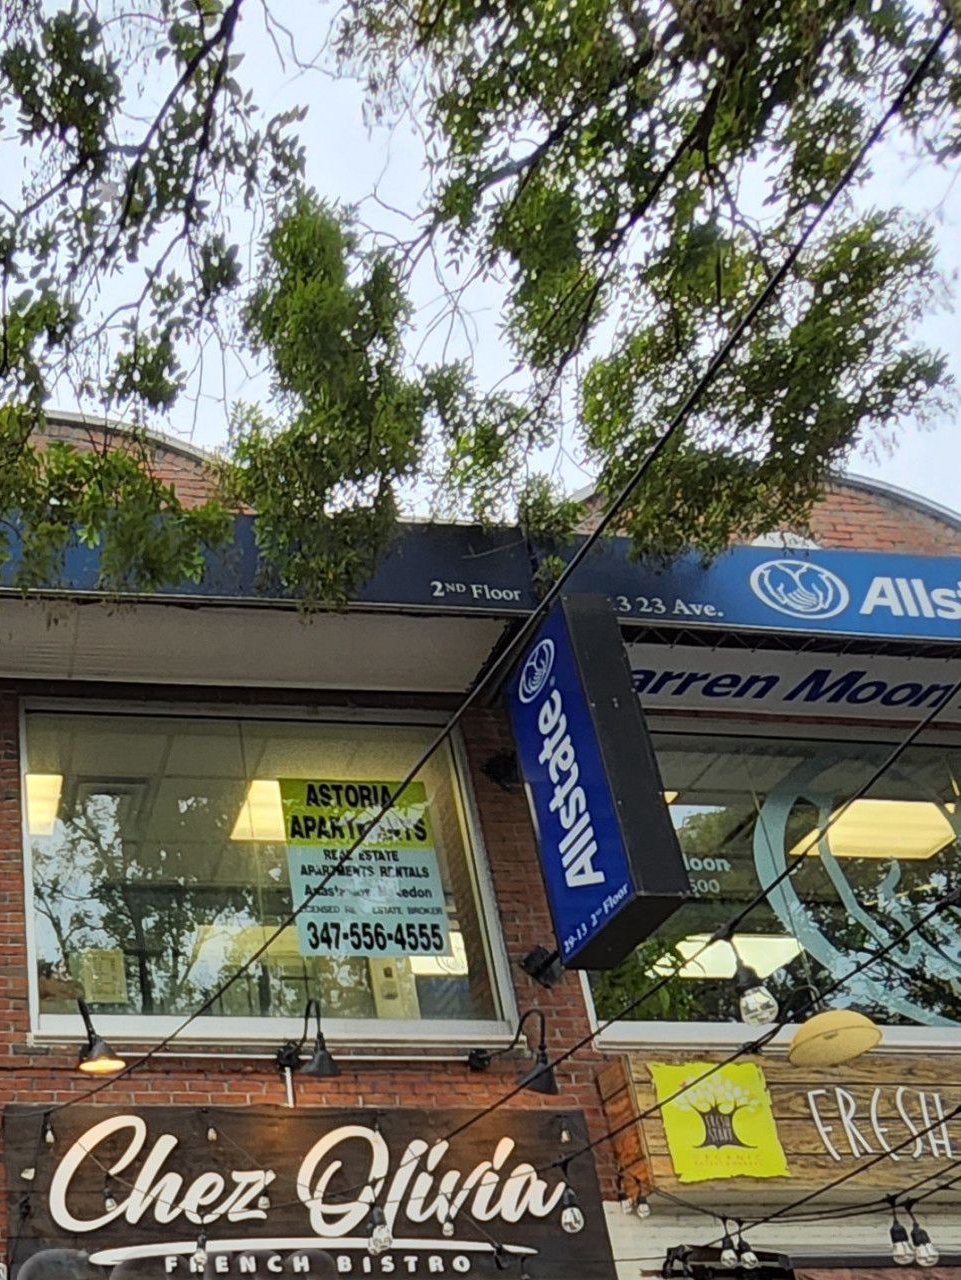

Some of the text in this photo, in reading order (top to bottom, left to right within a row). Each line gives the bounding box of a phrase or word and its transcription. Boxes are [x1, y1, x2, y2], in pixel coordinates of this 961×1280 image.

[471, 584, 522, 601] Floor
[636, 596, 667, 614] 23
[672, 598, 725, 617] Ave.
[859, 576, 961, 620] Alls
[630, 669, 955, 709] arren Moon
[306, 783, 395, 809] ASTORIA
[538, 689, 606, 888] Allstate
[603, 883, 629, 914] Floor
[306, 921, 444, 951] 347-556-4555
[808, 1086, 953, 1162] FRESH
[49, 1114, 567, 1240] Chez Olivia
[165, 1254, 472, 1274] FRENCH BISTRO
